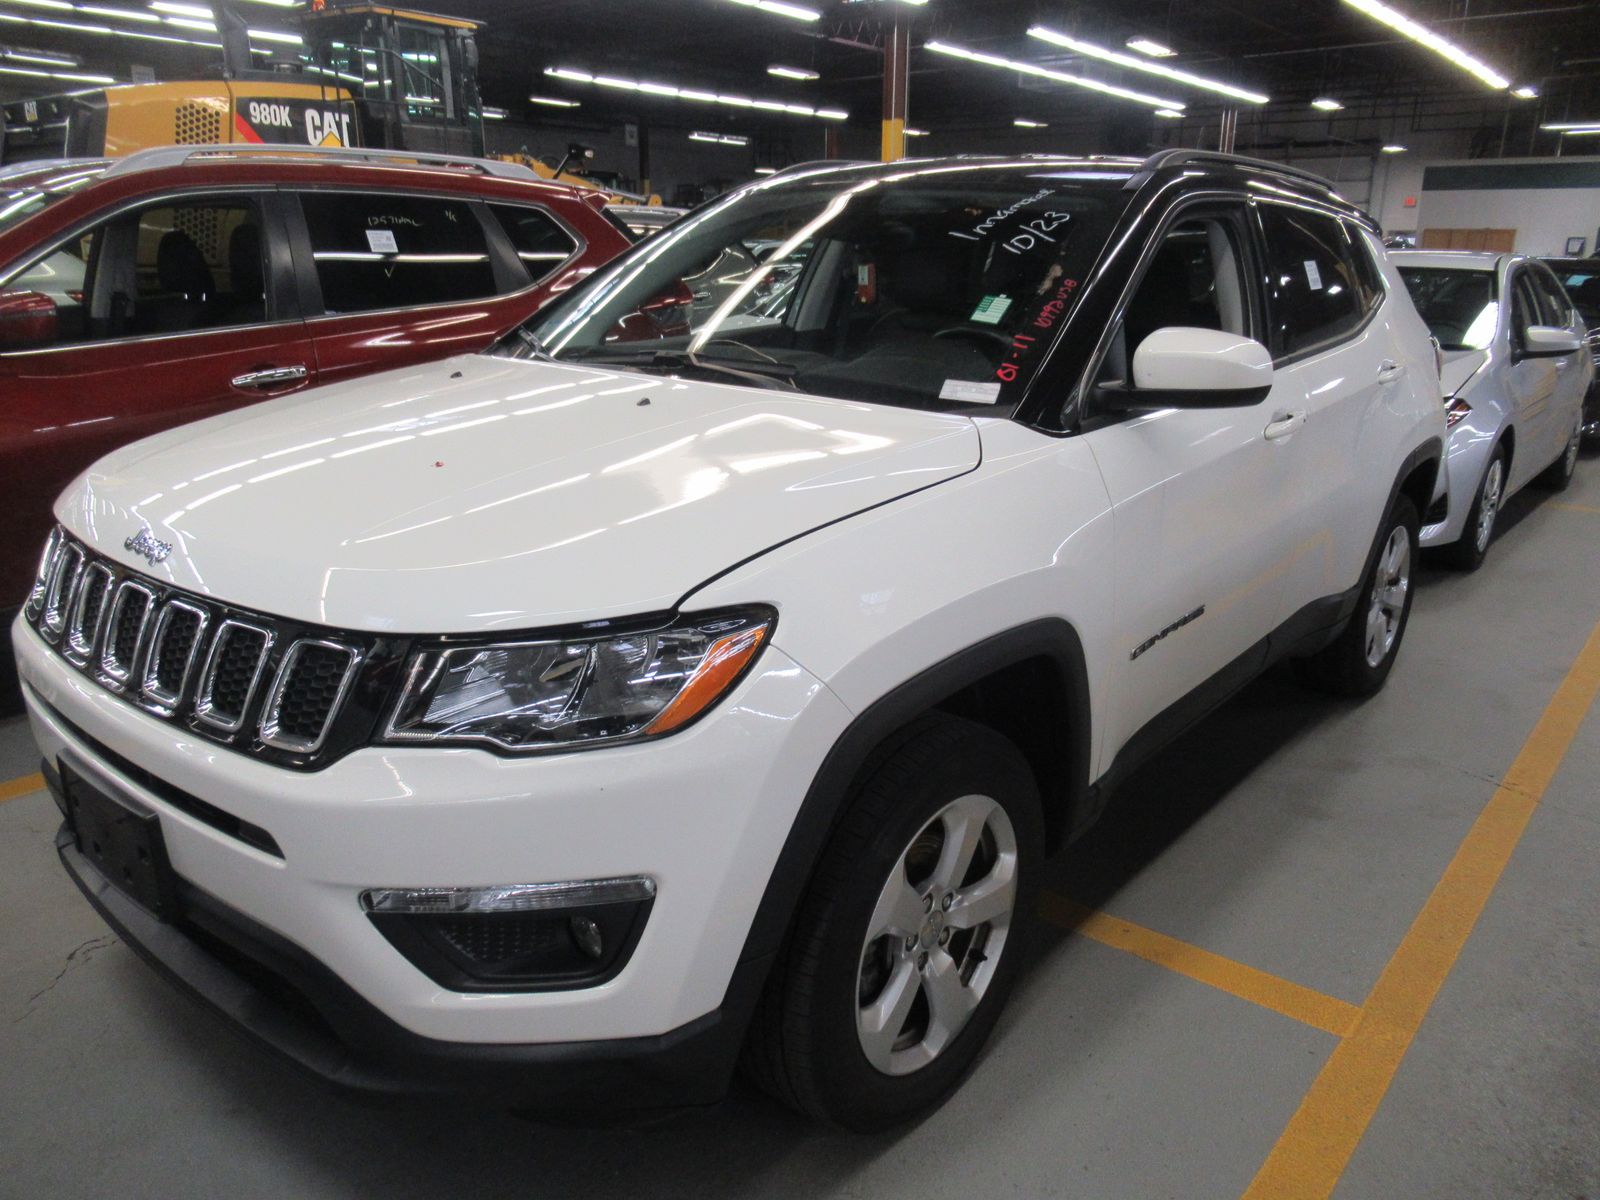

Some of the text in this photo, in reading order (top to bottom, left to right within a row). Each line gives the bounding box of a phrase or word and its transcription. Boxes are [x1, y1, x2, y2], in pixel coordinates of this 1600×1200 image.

[249, 101, 292, 127] 980K
[304, 108, 350, 149] CAT
[1002, 211, 1070, 255] 10/23
[124, 526, 173, 567] Jeep
